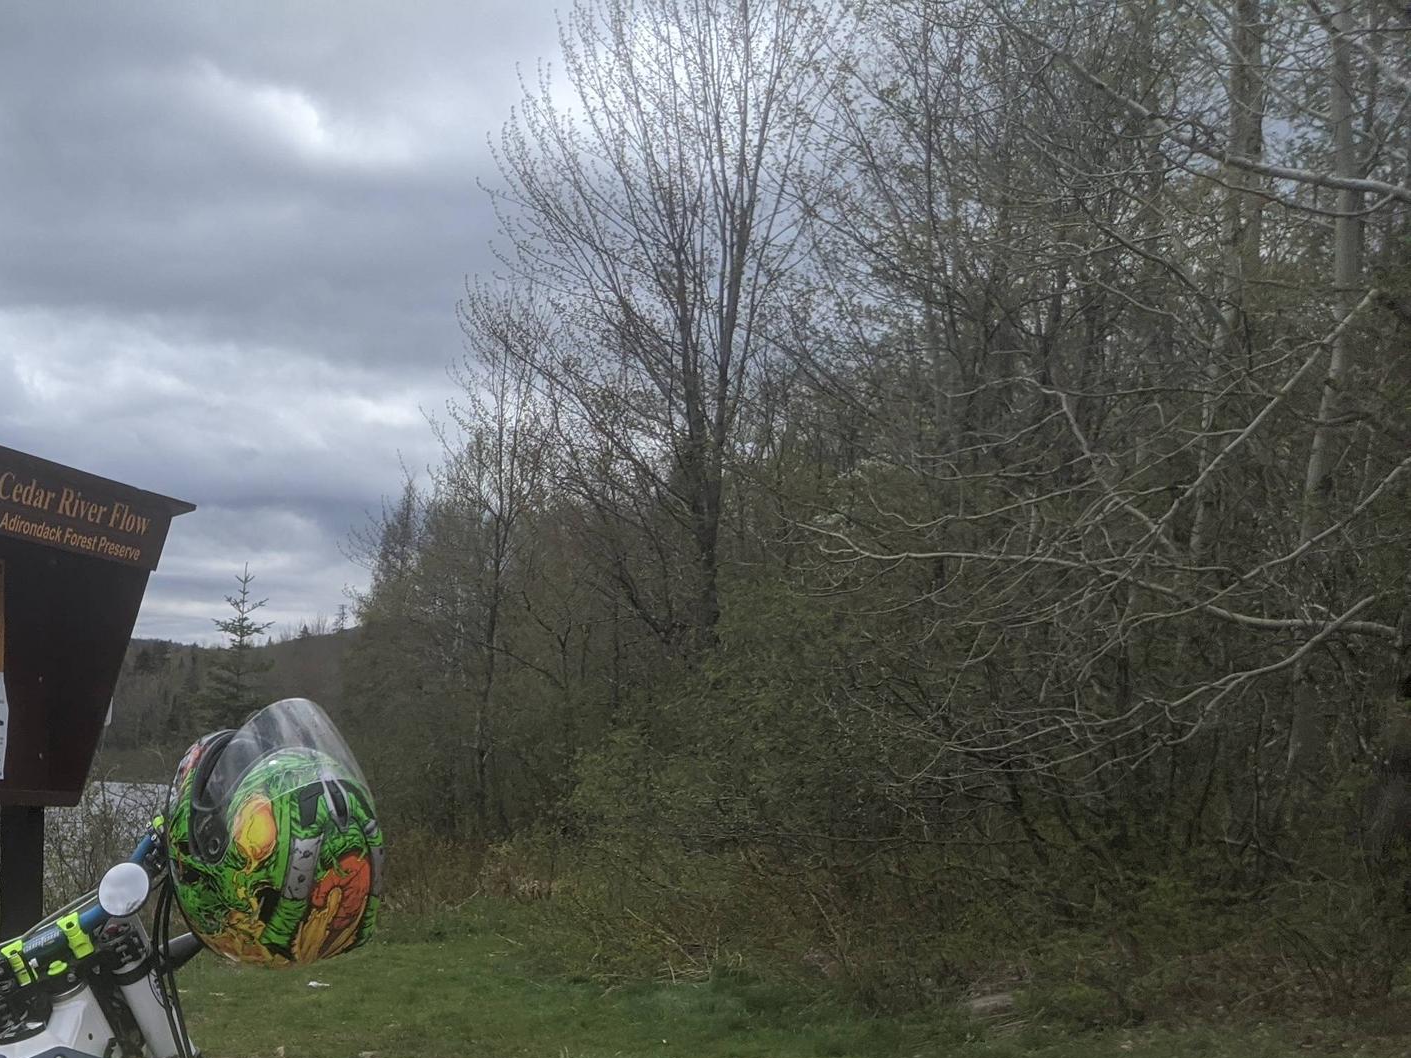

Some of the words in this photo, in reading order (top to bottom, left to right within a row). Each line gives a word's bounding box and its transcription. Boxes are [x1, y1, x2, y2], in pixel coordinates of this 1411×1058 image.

[0, 511, 62, 545] Adirondack
[64, 528, 97, 551] Forest
[98, 536, 141, 561] Preserve
[57, 487, 107, 524] River
[109, 502, 151, 536] Flow
